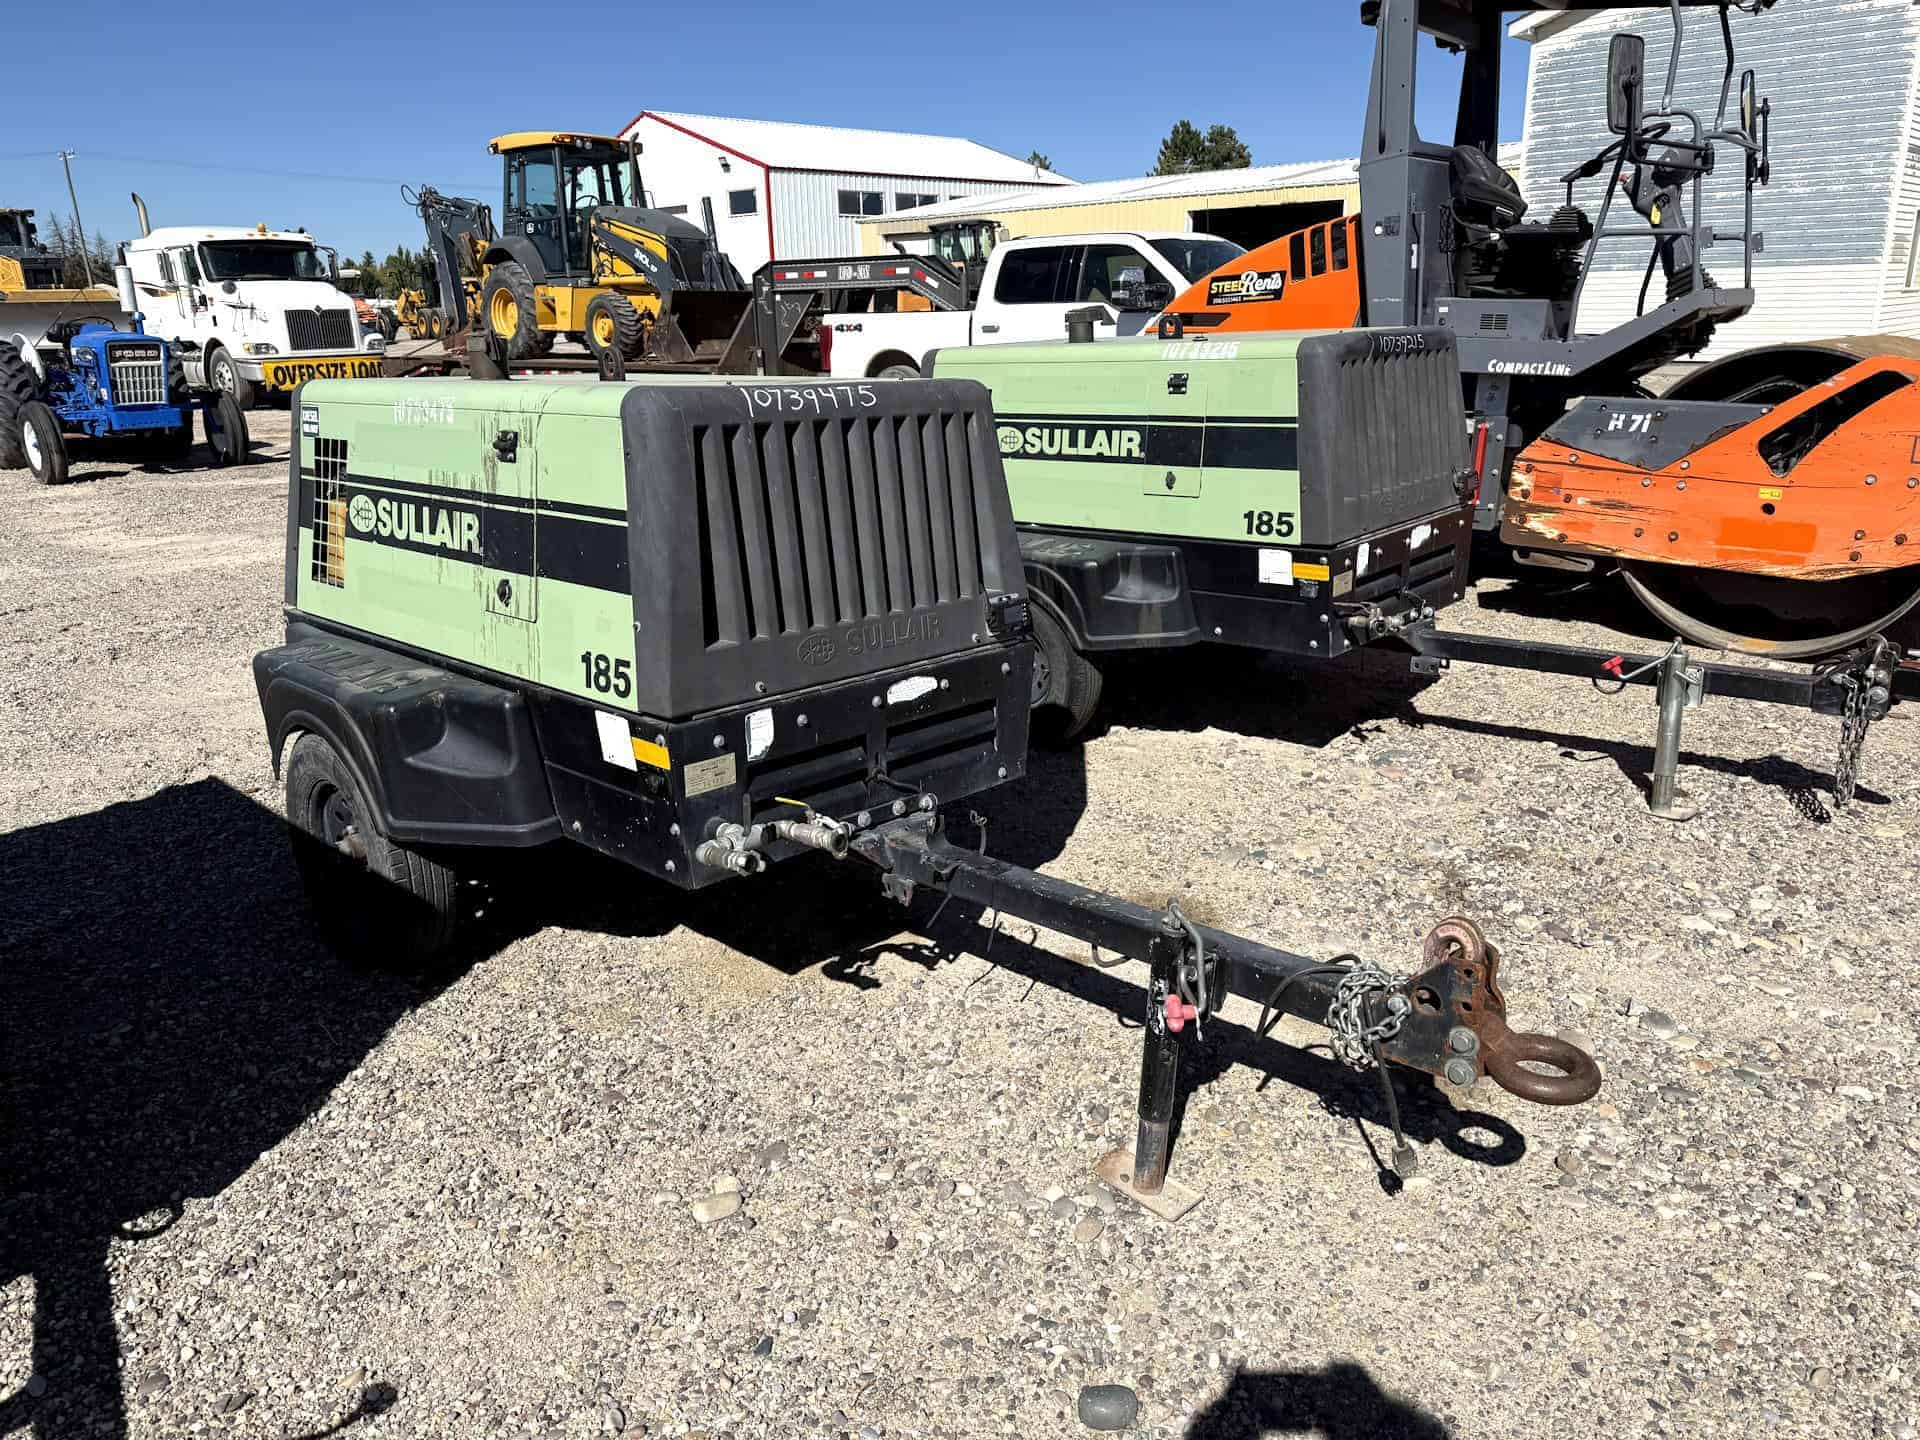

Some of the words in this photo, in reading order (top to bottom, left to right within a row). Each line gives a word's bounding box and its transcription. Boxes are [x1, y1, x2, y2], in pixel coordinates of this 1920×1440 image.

[1240, 270, 1283, 296] Rents
[1378, 333, 1425, 353] 10739215
[739, 385, 878, 418] 10739475
[1607, 413, 1625, 432] H
[1022, 426, 1143, 459] SULLAIR
[377, 497, 481, 554] SULLAIR
[1243, 510, 1296, 538] 185
[845, 613, 945, 657] SULLAIR
[581, 650, 633, 699] 185
